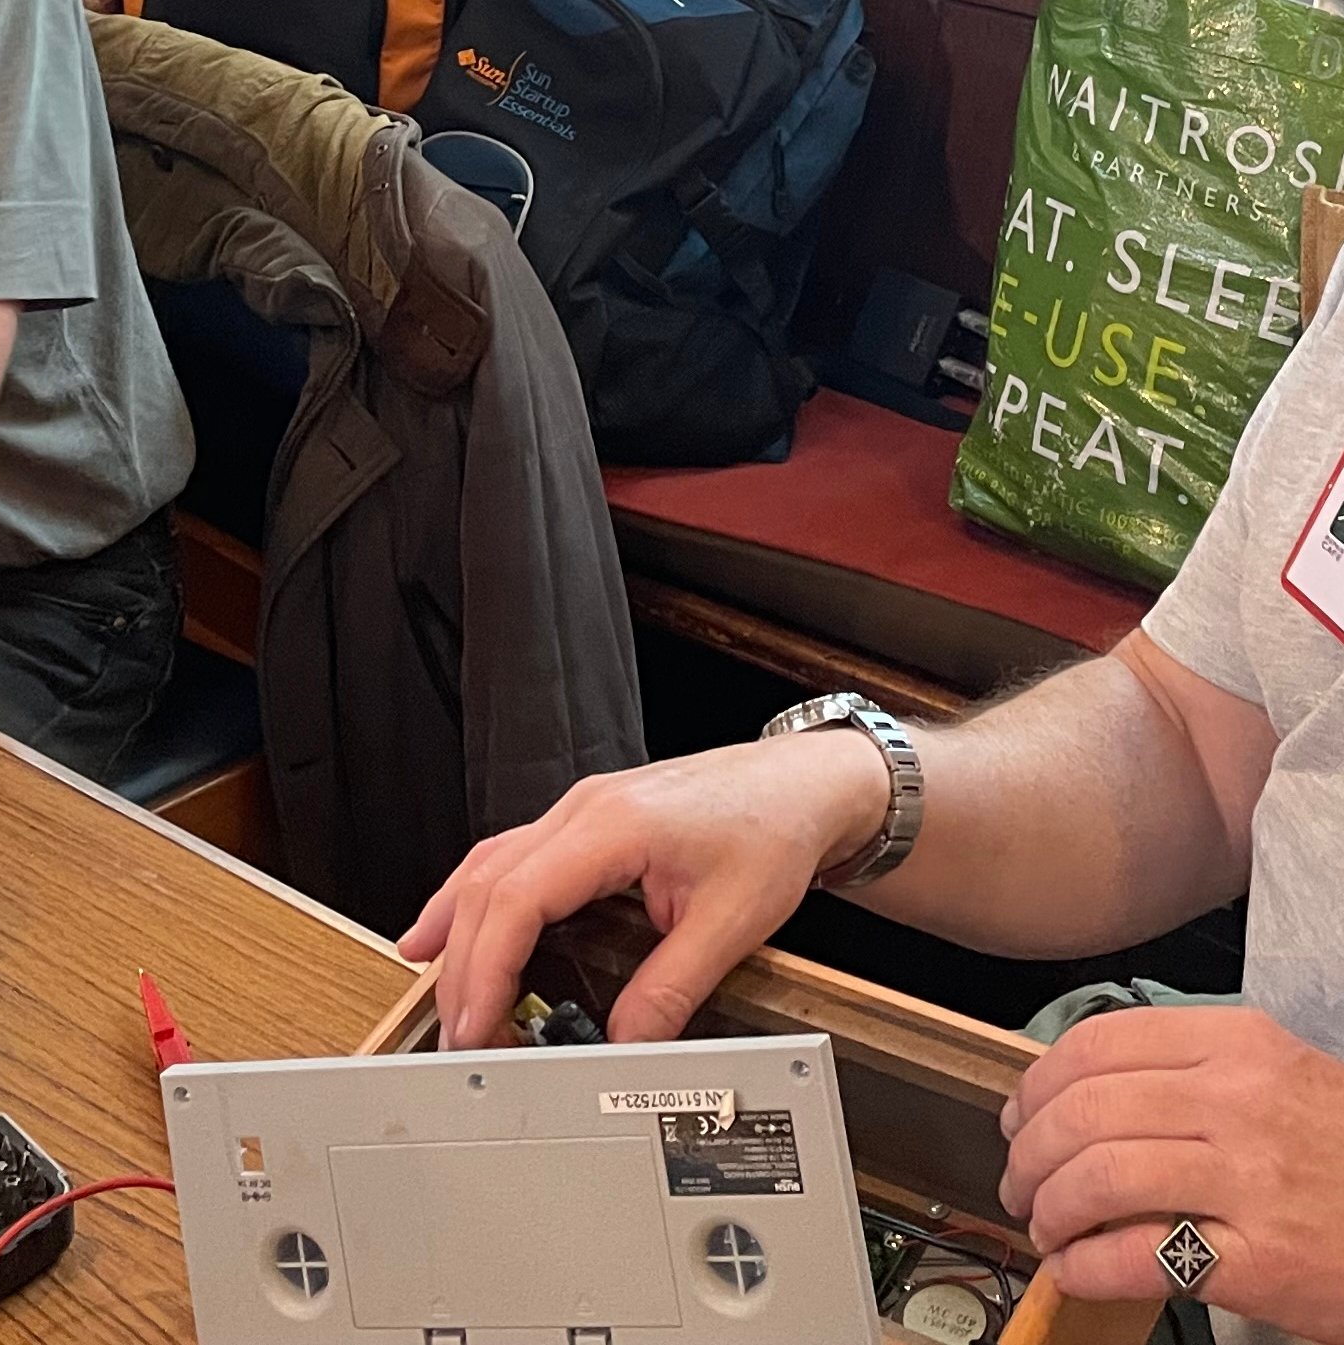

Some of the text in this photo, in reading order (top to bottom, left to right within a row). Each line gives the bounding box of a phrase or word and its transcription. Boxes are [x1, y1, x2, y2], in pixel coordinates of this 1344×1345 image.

[521, 62, 552, 91] Sun
[498, 95, 576, 141] Essentials
[510, 78, 571, 122] Startup
[1090, 150, 1267, 223] PARTNERS
[1002, 187, 1076, 273] AT.
[609, 1091, 702, 1109] 511007523-A
